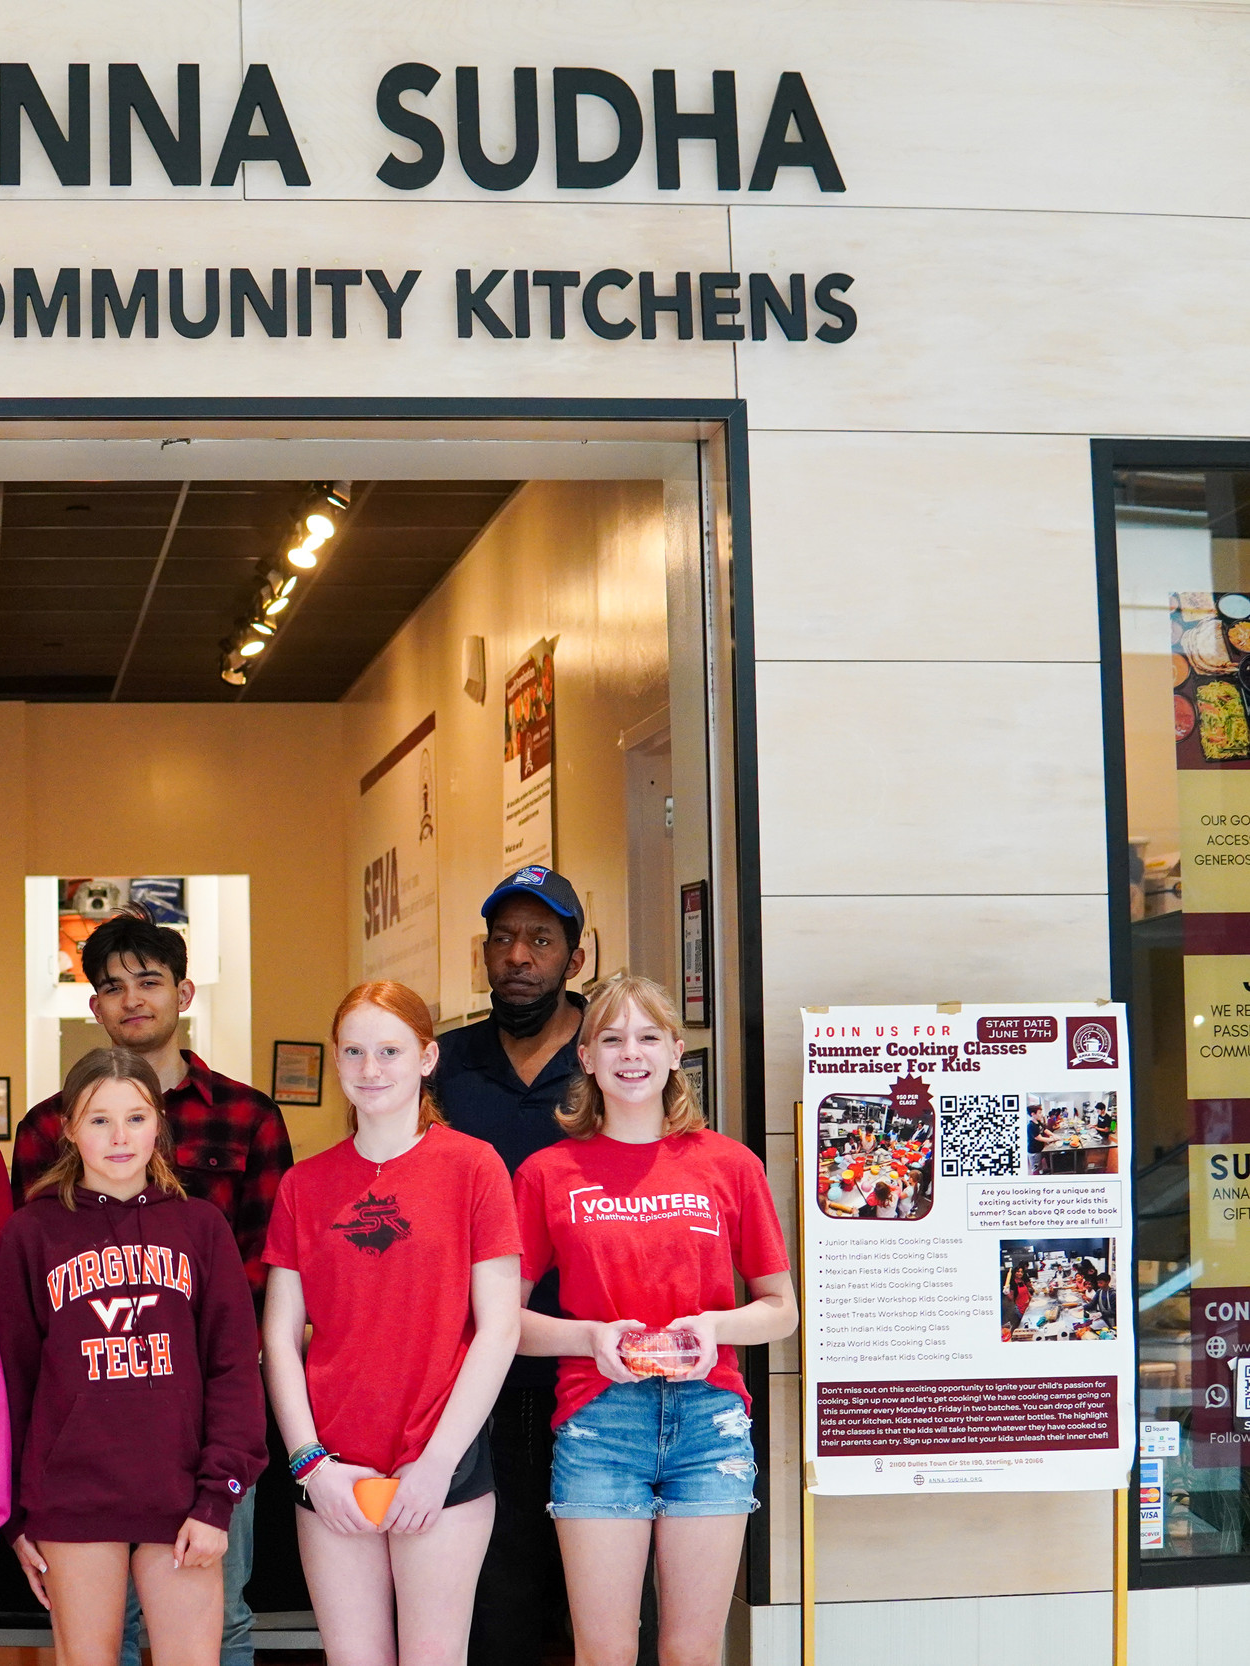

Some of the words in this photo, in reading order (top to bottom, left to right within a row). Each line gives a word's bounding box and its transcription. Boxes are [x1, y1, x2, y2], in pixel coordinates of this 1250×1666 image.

[376, 62, 847, 193] SUDHA
[455, 268, 858, 344] KITCHENS
[1201, 814, 1227, 826] OUR
[1206, 835, 1250, 846] ACCES
[364, 846, 400, 941] SEVA
[1210, 1004, 1231, 1017] WE
[985, 1019, 1020, 1029] START
[1023, 1019, 1051, 1029] DATE
[814, 1026, 860, 1037] JOIN
[875, 1025, 898, 1037] US
[913, 1025, 950, 1036] FOR
[988, 1029, 1019, 1039] JUNE
[1023, 1028, 1052, 1038] 17TH
[808, 1042, 881, 1057] Summer
[886, 1041, 958, 1060] Cooking
[963, 1041, 1027, 1055] Classes
[1200, 1045, 1250, 1058] COMM
[808, 1059, 902, 1074] Fundraiser
[906, 1059, 936, 1073] For
[941, 1058, 981, 1072] Kids
[1012, 1187, 1041, 1196] looking
[1062, 1187, 1089, 1195] unique
[1212, 1187, 1250, 1200] ANNA
[581, 1193, 710, 1214] VOLUNTEER
[978, 1198, 1010, 1207] exciting
[1011, 1198, 1042, 1206] activity
[1043, 1197, 1055, 1205] for
[583, 1215, 595, 1223] St.
[596, 1213, 638, 1223] Matthew's
[640, 1209, 681, 1223] Episcopal
[682, 1209, 712, 1220] Church
[1053, 1208, 1065, 1216] QR
[1018, 1218, 1045, 1226] before
[825, 1238, 848, 1246] Junior
[897, 1237, 931, 1246] Cooking
[46, 1244, 193, 1312] VIRGINIA
[88, 1293, 161, 1332] VT
[1204, 1301, 1250, 1322] CON
[81, 1333, 173, 1381] TECH
[889, 1385, 904, 1393] this
[905, 1384, 936, 1393] exciting
[937, 1383, 984, 1392] opportunity
[995, 1383, 1018, 1392] ignite
[1018, 1383, 1036, 1391] your
[1037, 1381, 1063, 1389] child's
[1063, 1381, 1093, 1390] passion
[1094, 1380, 1106, 1388] for
[1140, 1511, 1159, 1519] VISA
